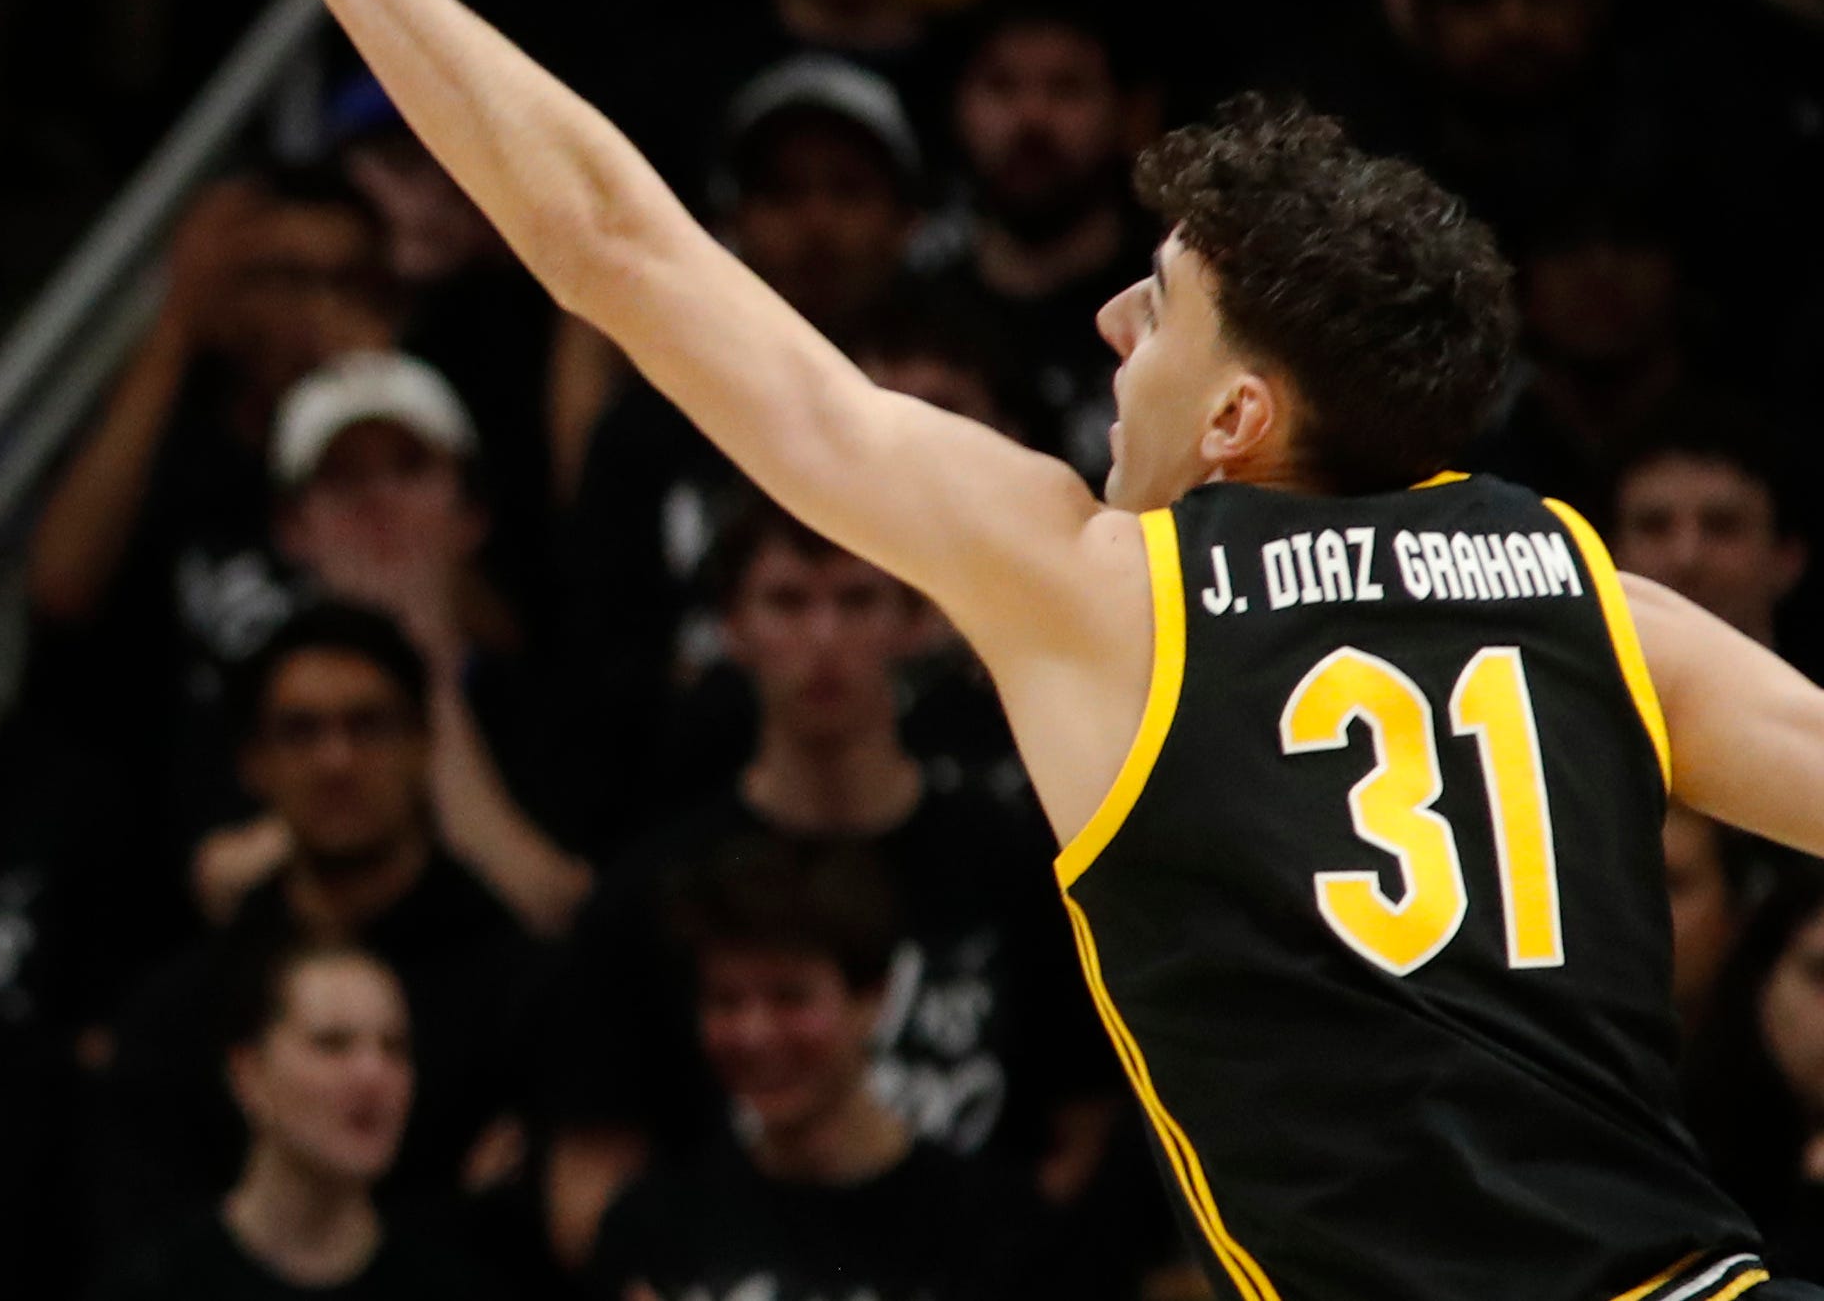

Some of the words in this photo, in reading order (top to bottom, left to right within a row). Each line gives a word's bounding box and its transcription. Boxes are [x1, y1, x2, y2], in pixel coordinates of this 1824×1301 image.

[1202, 545, 1248, 616] J.
[1262, 527, 1384, 611] DIAZ
[1392, 529, 1583, 601] GRAHAM
[1279, 645, 1565, 977] 31
